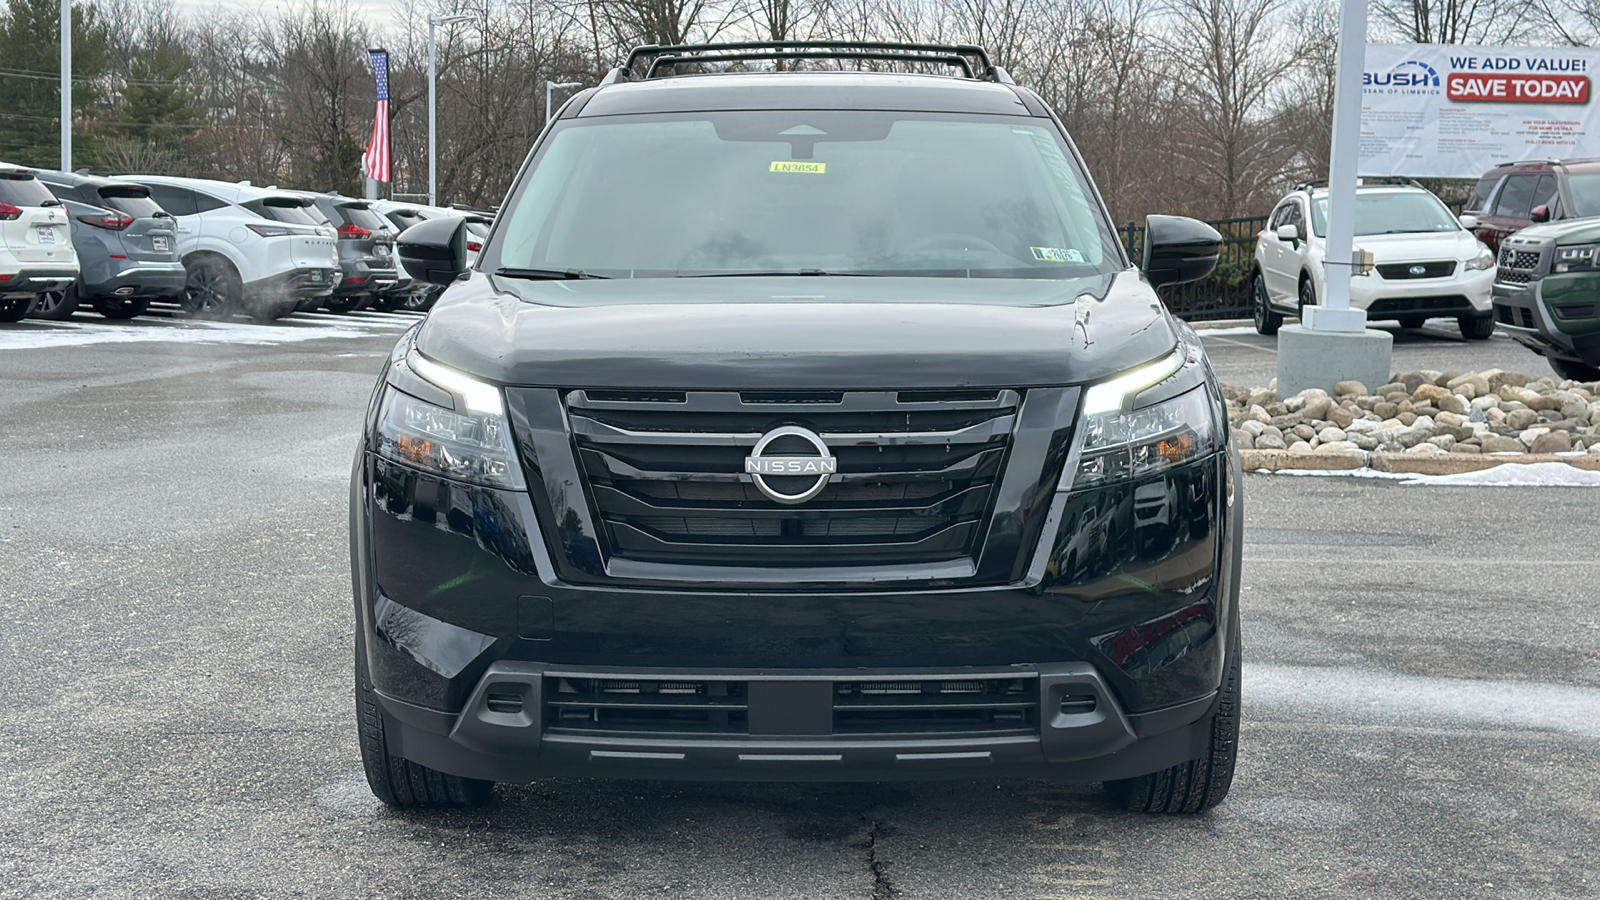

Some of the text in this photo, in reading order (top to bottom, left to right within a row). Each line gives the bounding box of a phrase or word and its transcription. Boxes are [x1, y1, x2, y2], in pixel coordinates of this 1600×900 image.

[1450, 57, 1587, 71] WE ADD VALUE!
[1362, 73, 1429, 86] BUSH
[1450, 78, 1585, 98] SAVE TODAY
[774, 163, 819, 172] LN3654
[747, 460, 834, 472] NISSAN
